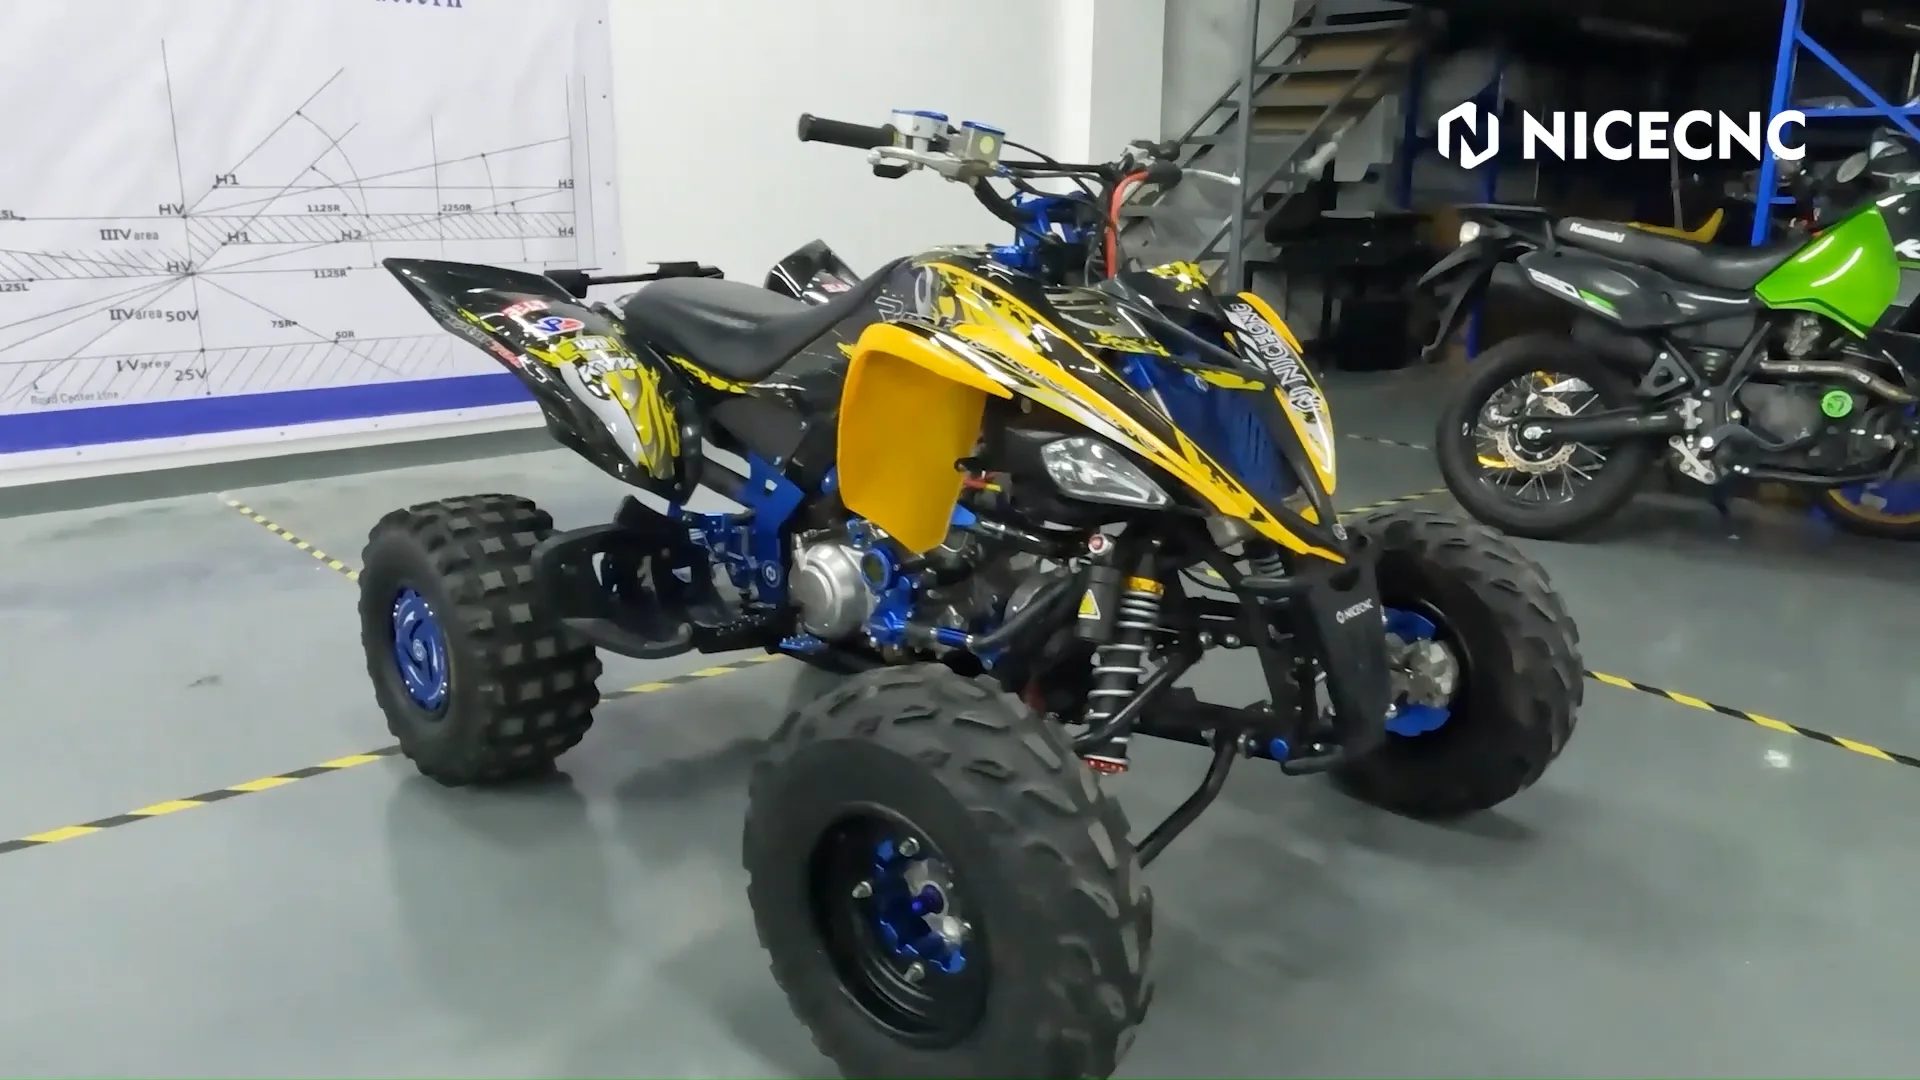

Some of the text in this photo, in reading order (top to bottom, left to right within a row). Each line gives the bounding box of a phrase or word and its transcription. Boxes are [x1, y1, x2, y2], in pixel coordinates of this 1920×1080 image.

[215, 174, 240, 186] H1
[558, 178, 575, 189] H3
[159, 204, 184, 215] HV
[307, 204, 341, 213] 1125R
[227, 231, 250, 243] H1
[341, 230, 362, 241] H2
[558, 226, 575, 237] H4
[166, 261, 192, 273] HV
[165, 309, 199, 322] 50V
[175, 367, 207, 381] 25V
